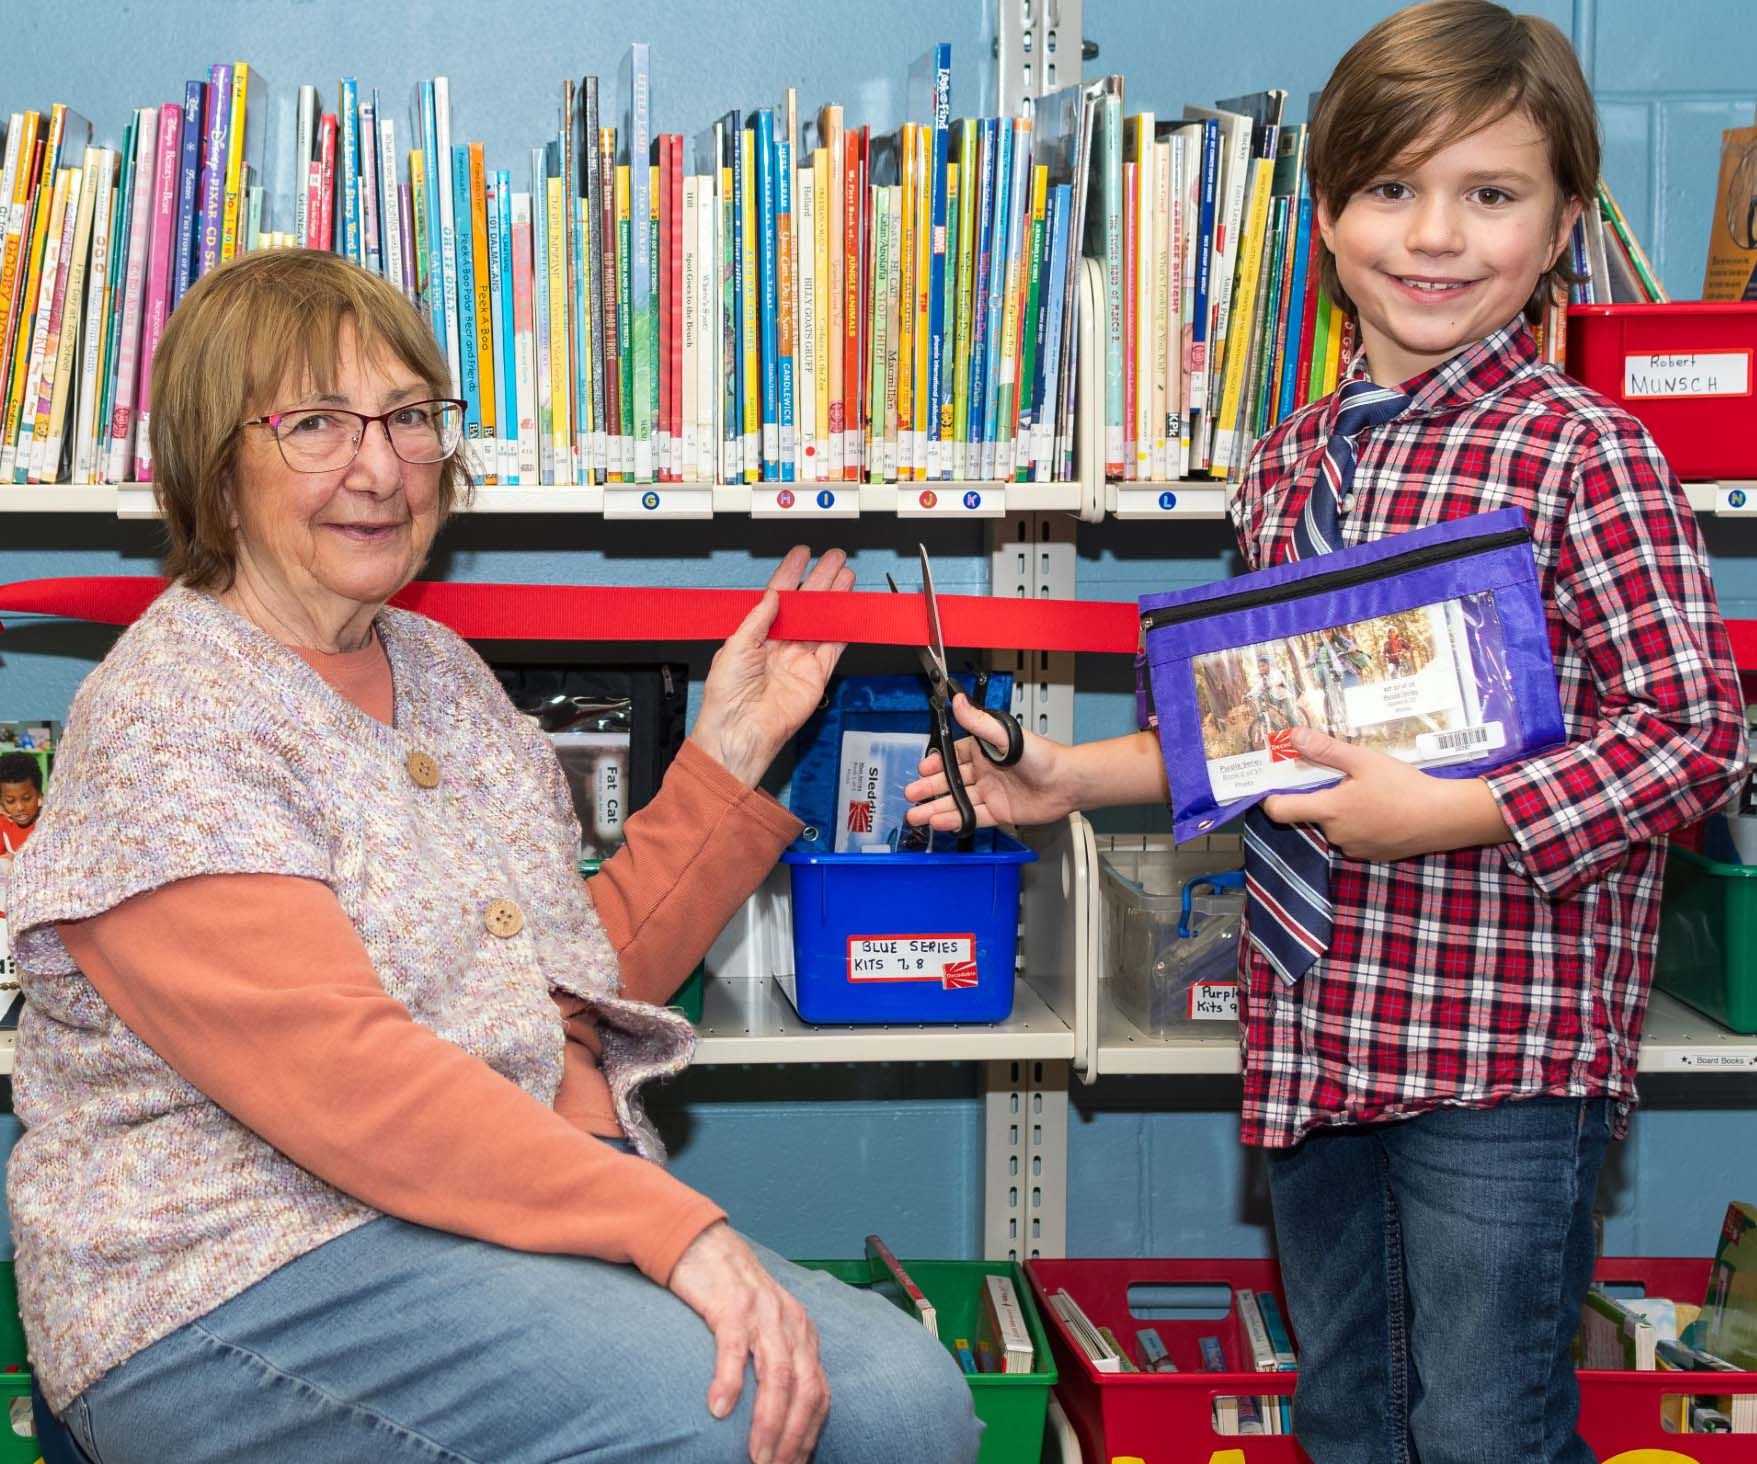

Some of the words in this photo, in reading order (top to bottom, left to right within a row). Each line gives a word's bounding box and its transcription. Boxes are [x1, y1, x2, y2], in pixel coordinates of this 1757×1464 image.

[187, 97, 199, 122] Disney
[938, 103, 949, 130] find
[206, 126, 227, 171] Disney
[735, 149, 740, 159] to
[163, 151, 176, 179] Beauty
[848, 170, 855, 182] My
[184, 168, 196, 200] Frozen
[162, 191, 174, 214] Beast
[208, 178, 219, 219] PIXAR
[489, 215, 497, 229] 101
[1110, 215, 1118, 230] THE
[1174, 200, 1182, 258] GARBAGE
[182, 233, 190, 254] STORY
[206, 227, 216, 246] CD
[443, 226, 451, 252] OH!
[621, 223, 629, 257] PRINCESS
[639, 221, 647, 263] HARPER
[651, 241, 657, 249] OF
[780, 232, 791, 254] You
[934, 226, 945, 254] MARVEL
[1033, 223, 1041, 263] ARMADILLY
[181, 258, 188, 268] OF
[431, 251, 441, 274] CAT
[444, 257, 452, 272] IF
[461, 233, 471, 287] Peek-A-Boo
[604, 253, 614, 266] OLD
[780, 256, 791, 276] Can
[890, 260, 899, 274] HI,
[76, 263, 85, 285] First
[179, 270, 188, 291] ANNA
[69, 289, 82, 306] Day
[463, 288, 472, 312] Polar
[686, 295, 693, 304] to
[782, 283, 791, 300] Do
[805, 277, 813, 305] BILLY
[1222, 276, 1231, 304] Annick
[876, 290, 886, 320] STOP,
[464, 316, 473, 340] Bear
[479, 285, 489, 350] Peek-A-Boo
[782, 317, 791, 340] Sam
[805, 307, 813, 339] GOATS
[1111, 304, 1120, 332] MARCO
[1219, 307, 1228, 329] Press
[67, 324, 75, 340] Zoo
[63, 343, 73, 372] School
[466, 341, 475, 358] and
[606, 340, 617, 360] TRUCK
[805, 341, 813, 374] GRUFF
[876, 328, 886, 365] THIEF!
[1650, 354, 1696, 369] Robert
[467, 360, 476, 392] Friends
[887, 350, 897, 410] Macmillan
[1631, 373, 1719, 395] MUNSCH
[783, 363, 791, 420] CANDLEWICK
[932, 398, 940, 433] publications,
[607, 766, 618, 790] Fat
[607, 799, 618, 824] Cat
[862, 941, 898, 954] BLUE
[910, 940, 959, 953] SERIES
[854, 958, 884, 971] KITS
[915, 958, 924, 970] 8
[1196, 1001, 1223, 1013] Kits
[1230, 1004, 1238, 1013] 9
[1696, 1056, 1720, 1065] Board
[1721, 1056, 1745, 1065] Books
